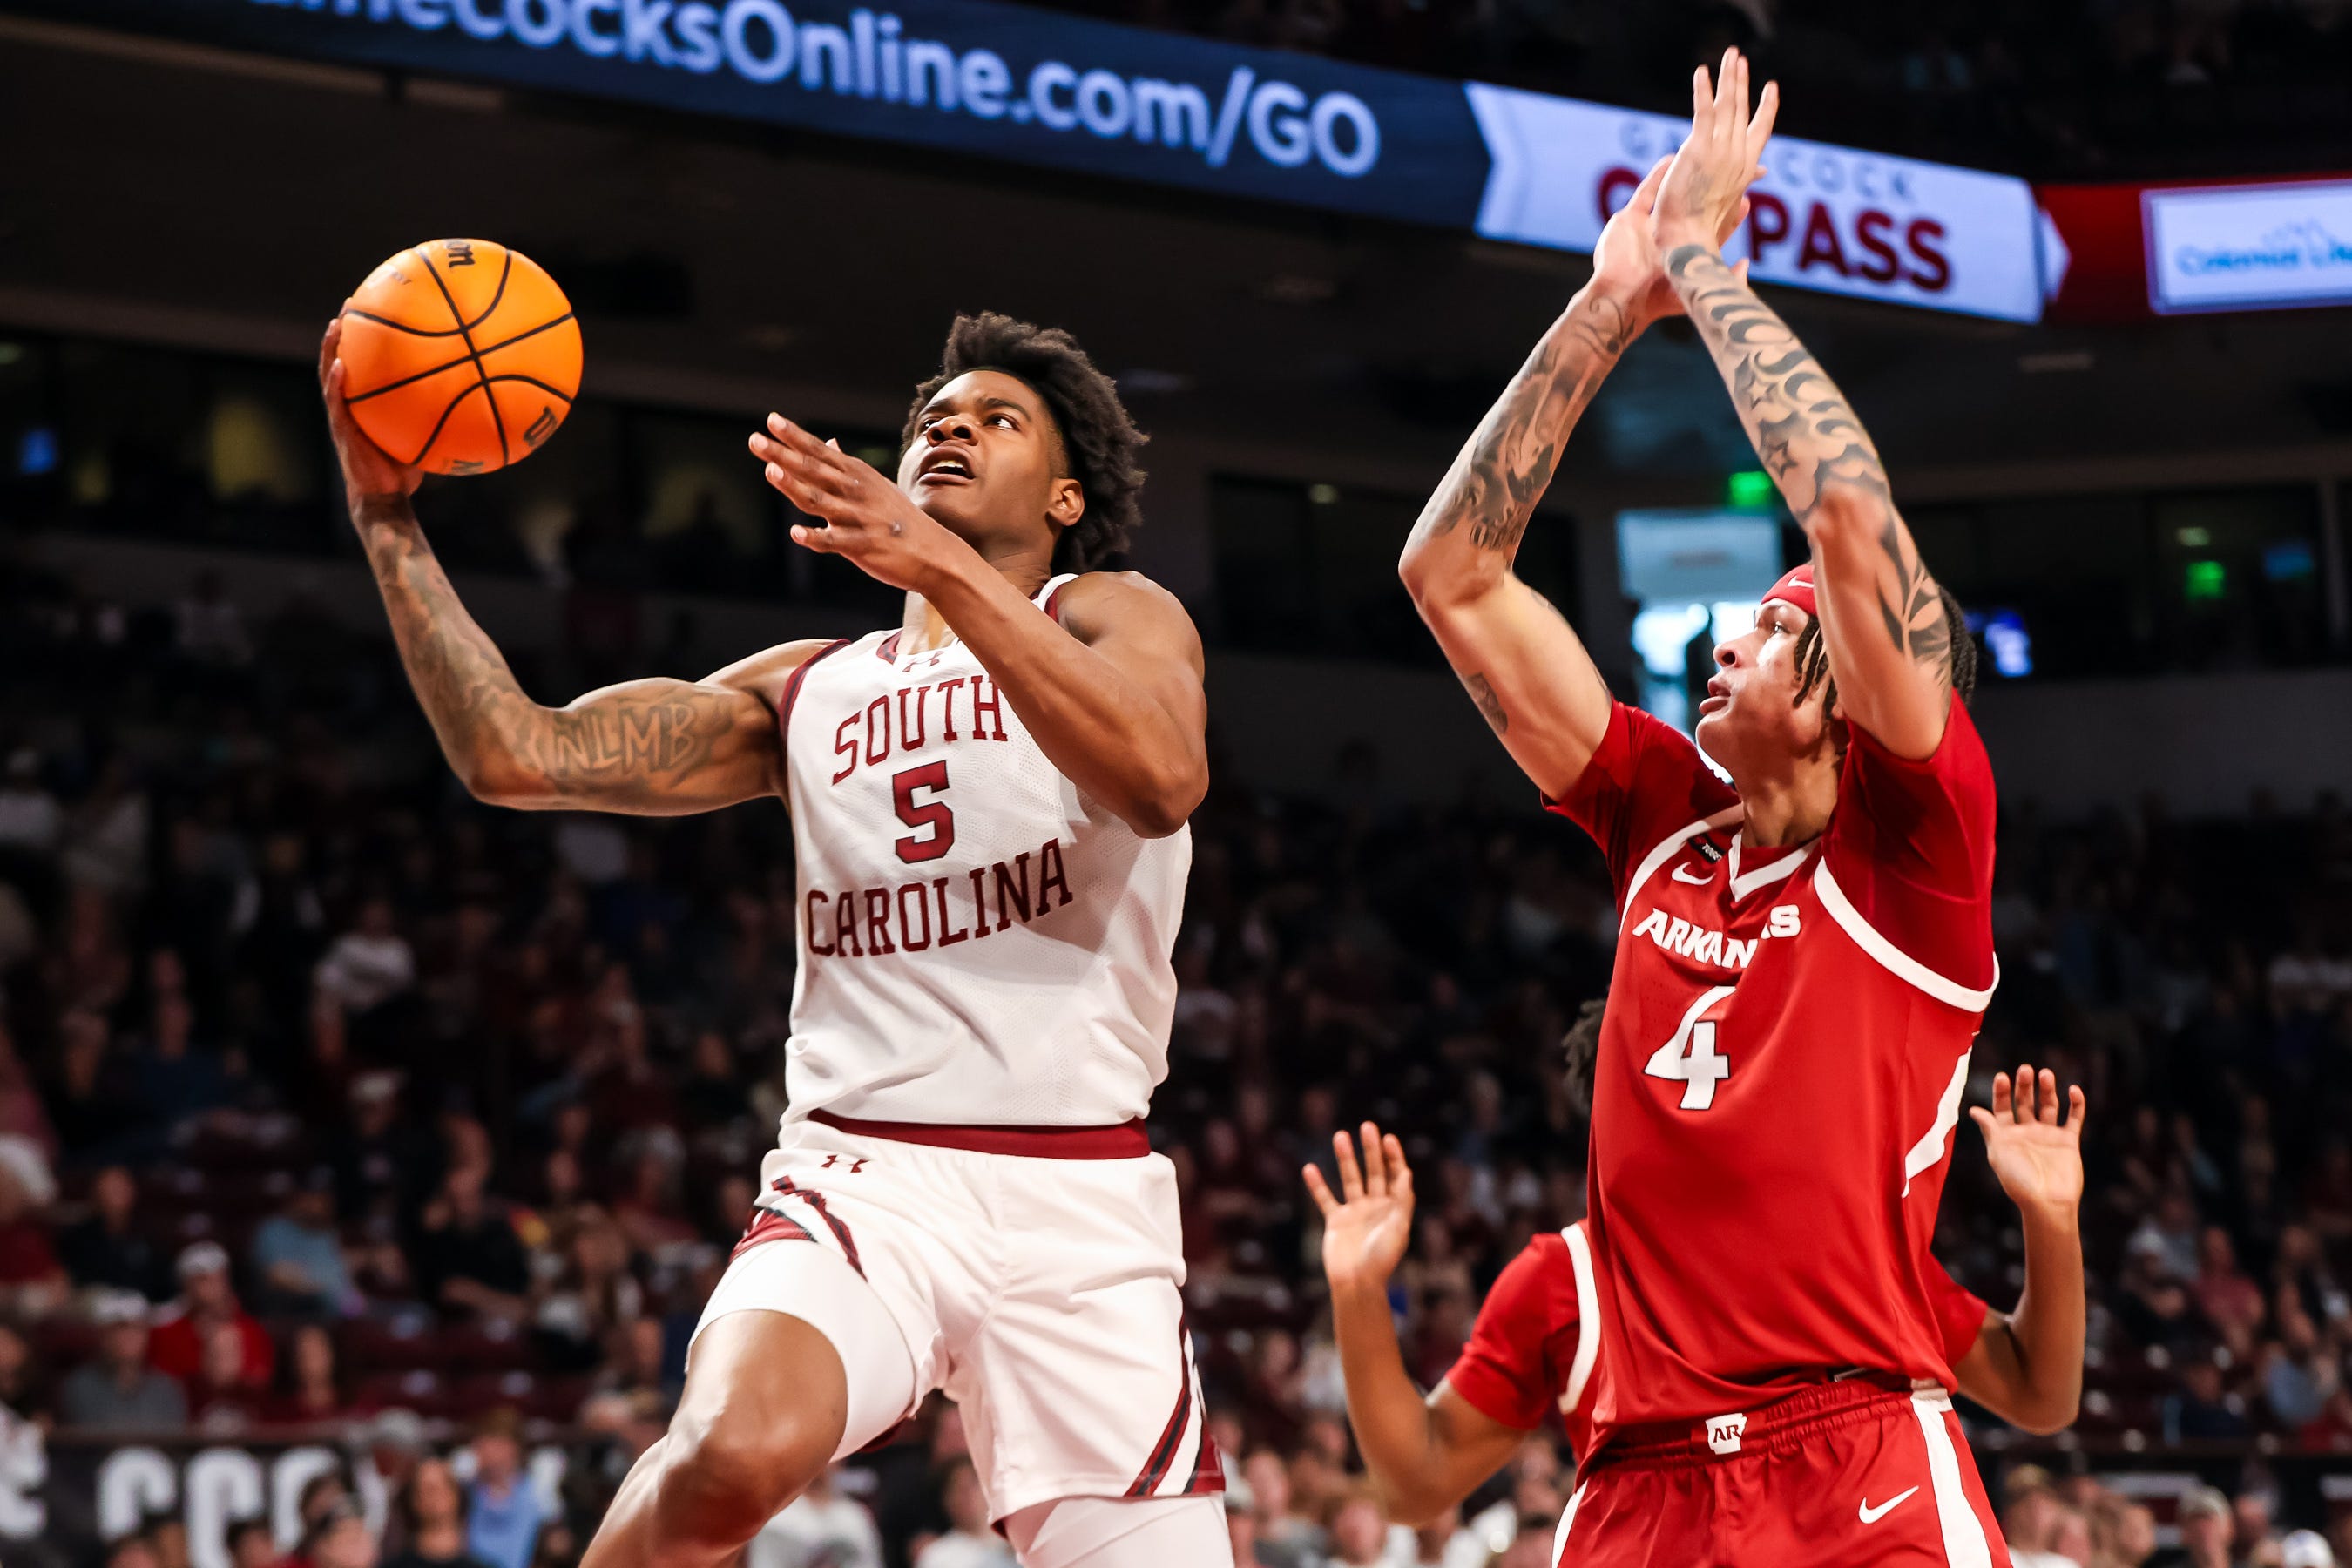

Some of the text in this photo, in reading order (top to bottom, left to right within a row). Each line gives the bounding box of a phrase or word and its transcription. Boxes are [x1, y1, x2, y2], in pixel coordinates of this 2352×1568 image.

[832, 675, 1008, 786] SOUTH
[892, 760, 955, 864] 5
[807, 838, 1073, 957] CAROLINA
[1632, 904, 1801, 969] ARKANS
[1644, 985, 1737, 1110] 4
[1713, 1424, 1742, 1443] AR
